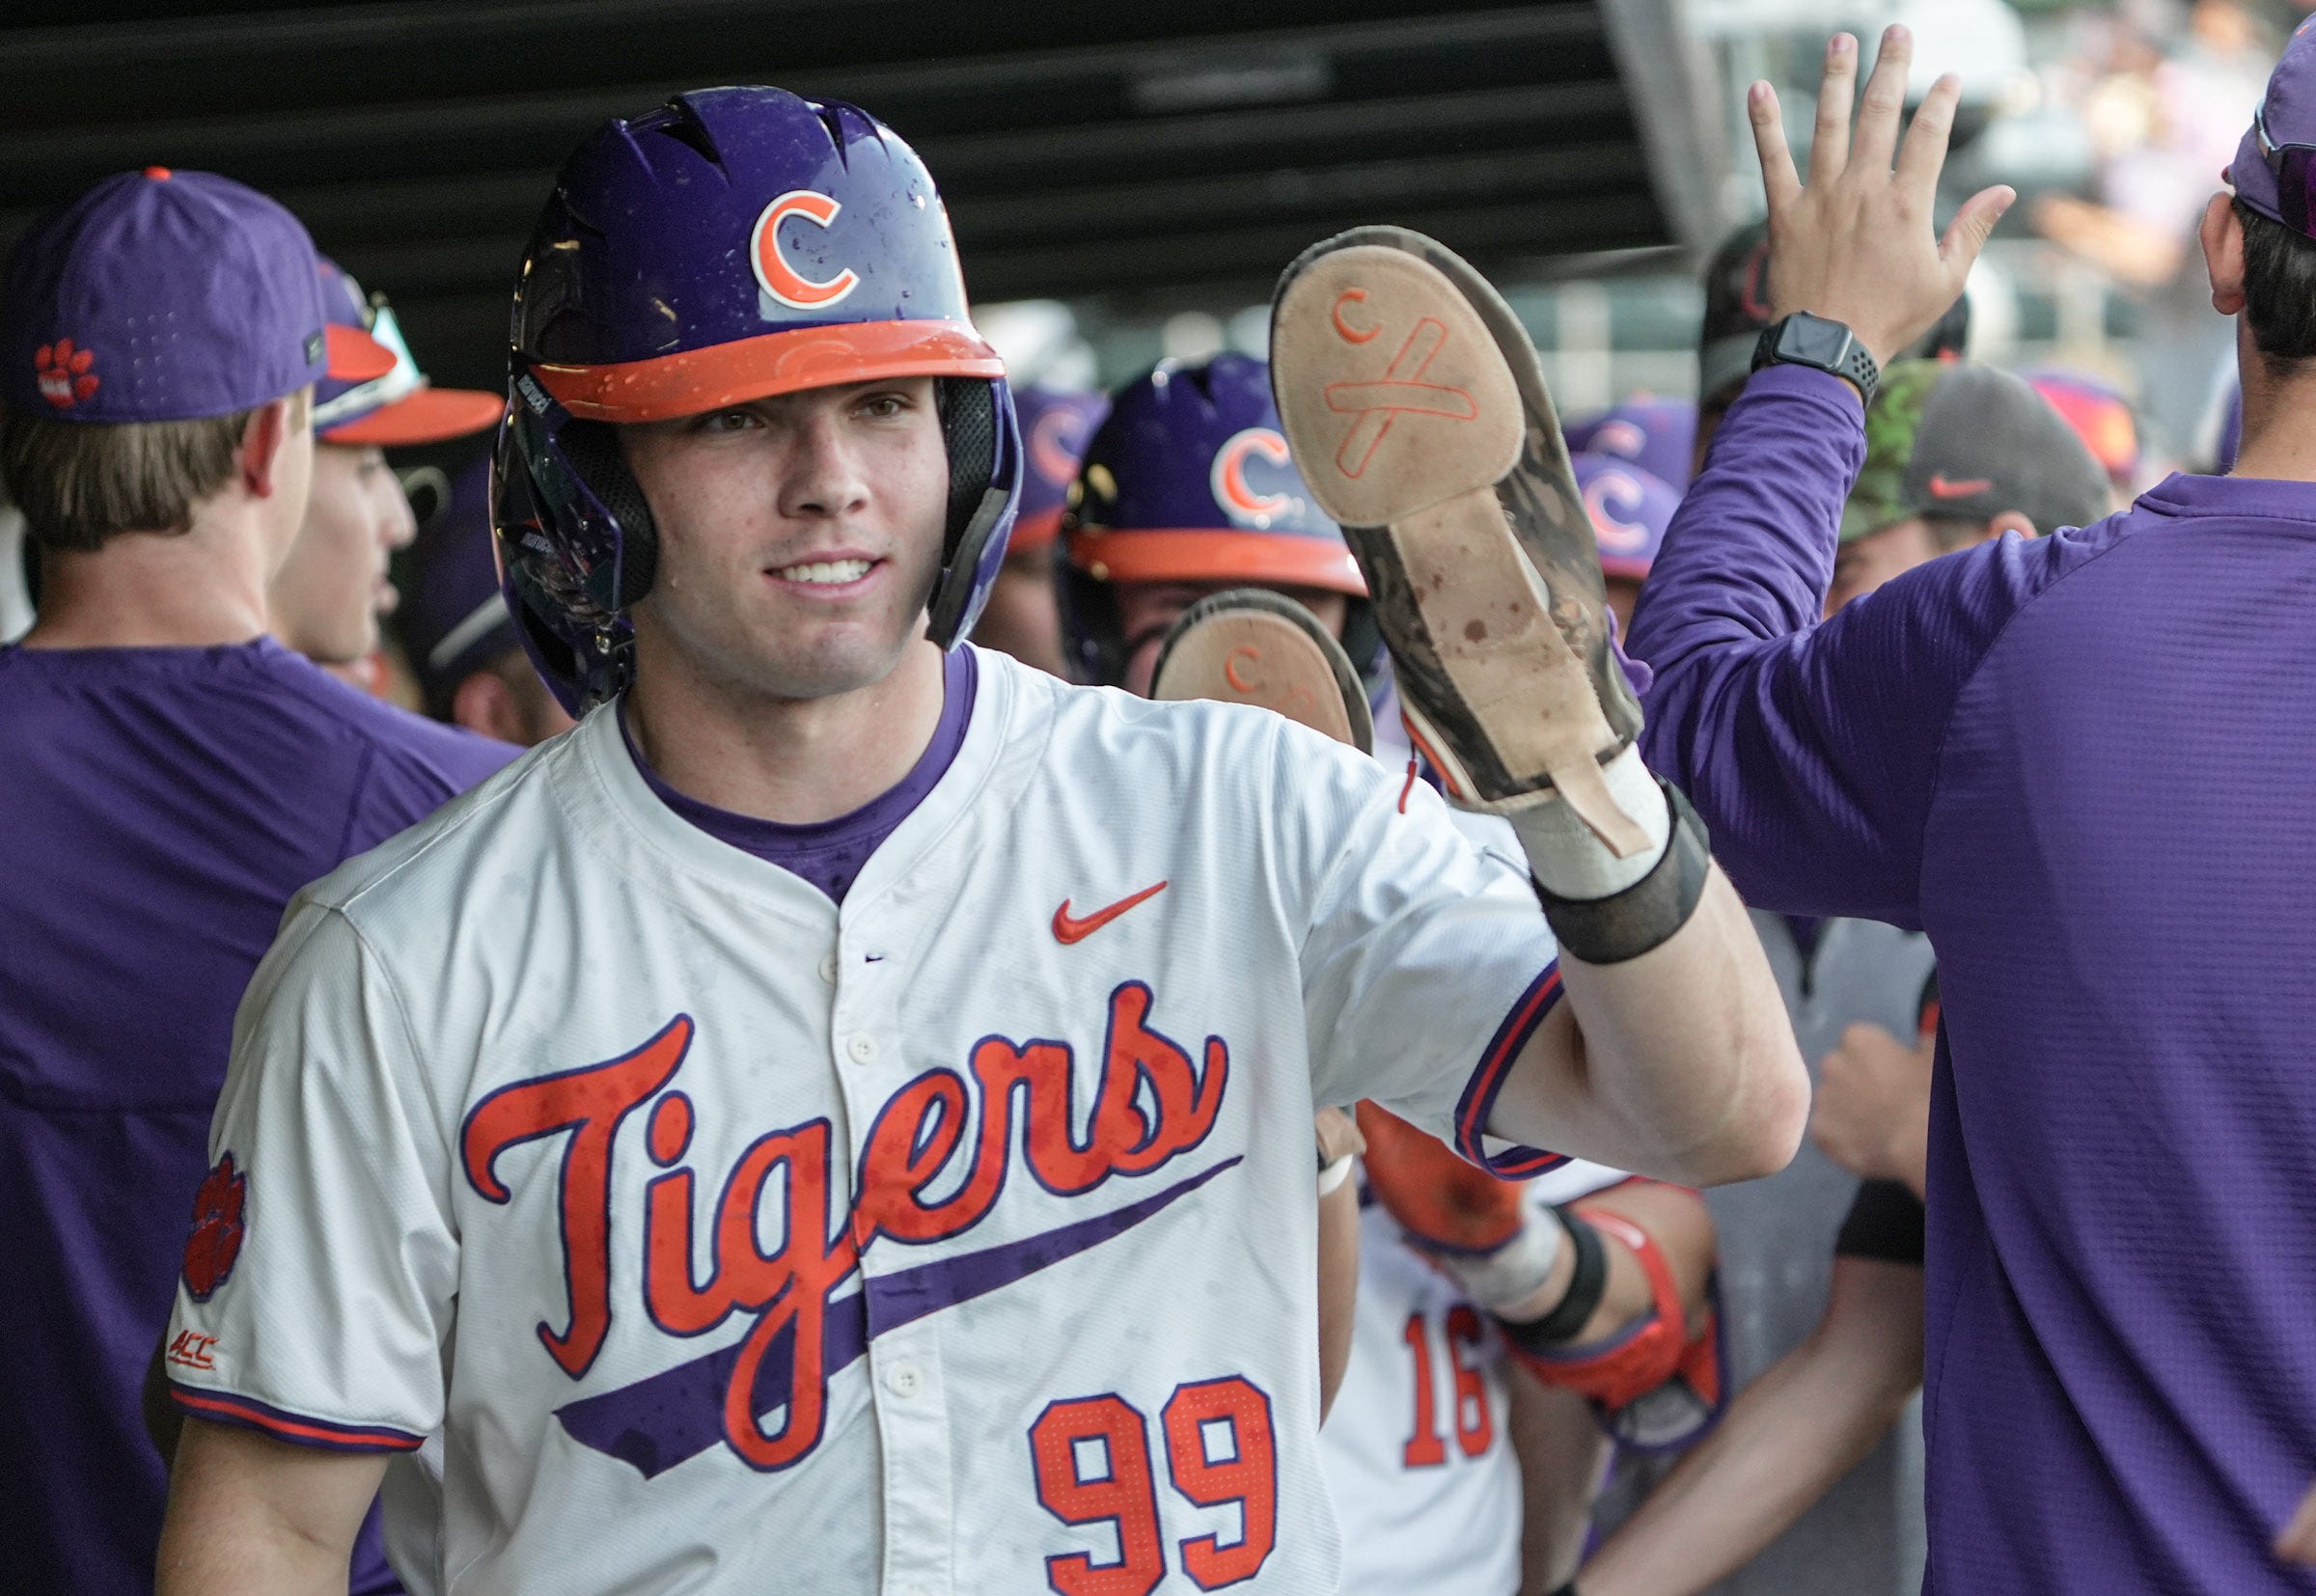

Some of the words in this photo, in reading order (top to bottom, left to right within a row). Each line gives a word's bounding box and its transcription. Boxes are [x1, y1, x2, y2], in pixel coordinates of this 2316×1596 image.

[750, 189, 860, 310] C
[1332, 288, 1384, 344] C
[1209, 427, 1294, 526] C
[1583, 469, 1649, 554] C
[459, 979, 1228, 1473] Tigers
[169, 1329, 220, 1363] ACC
[1403, 1305, 1495, 1468] 16
[1028, 1373, 1279, 1596] 99
